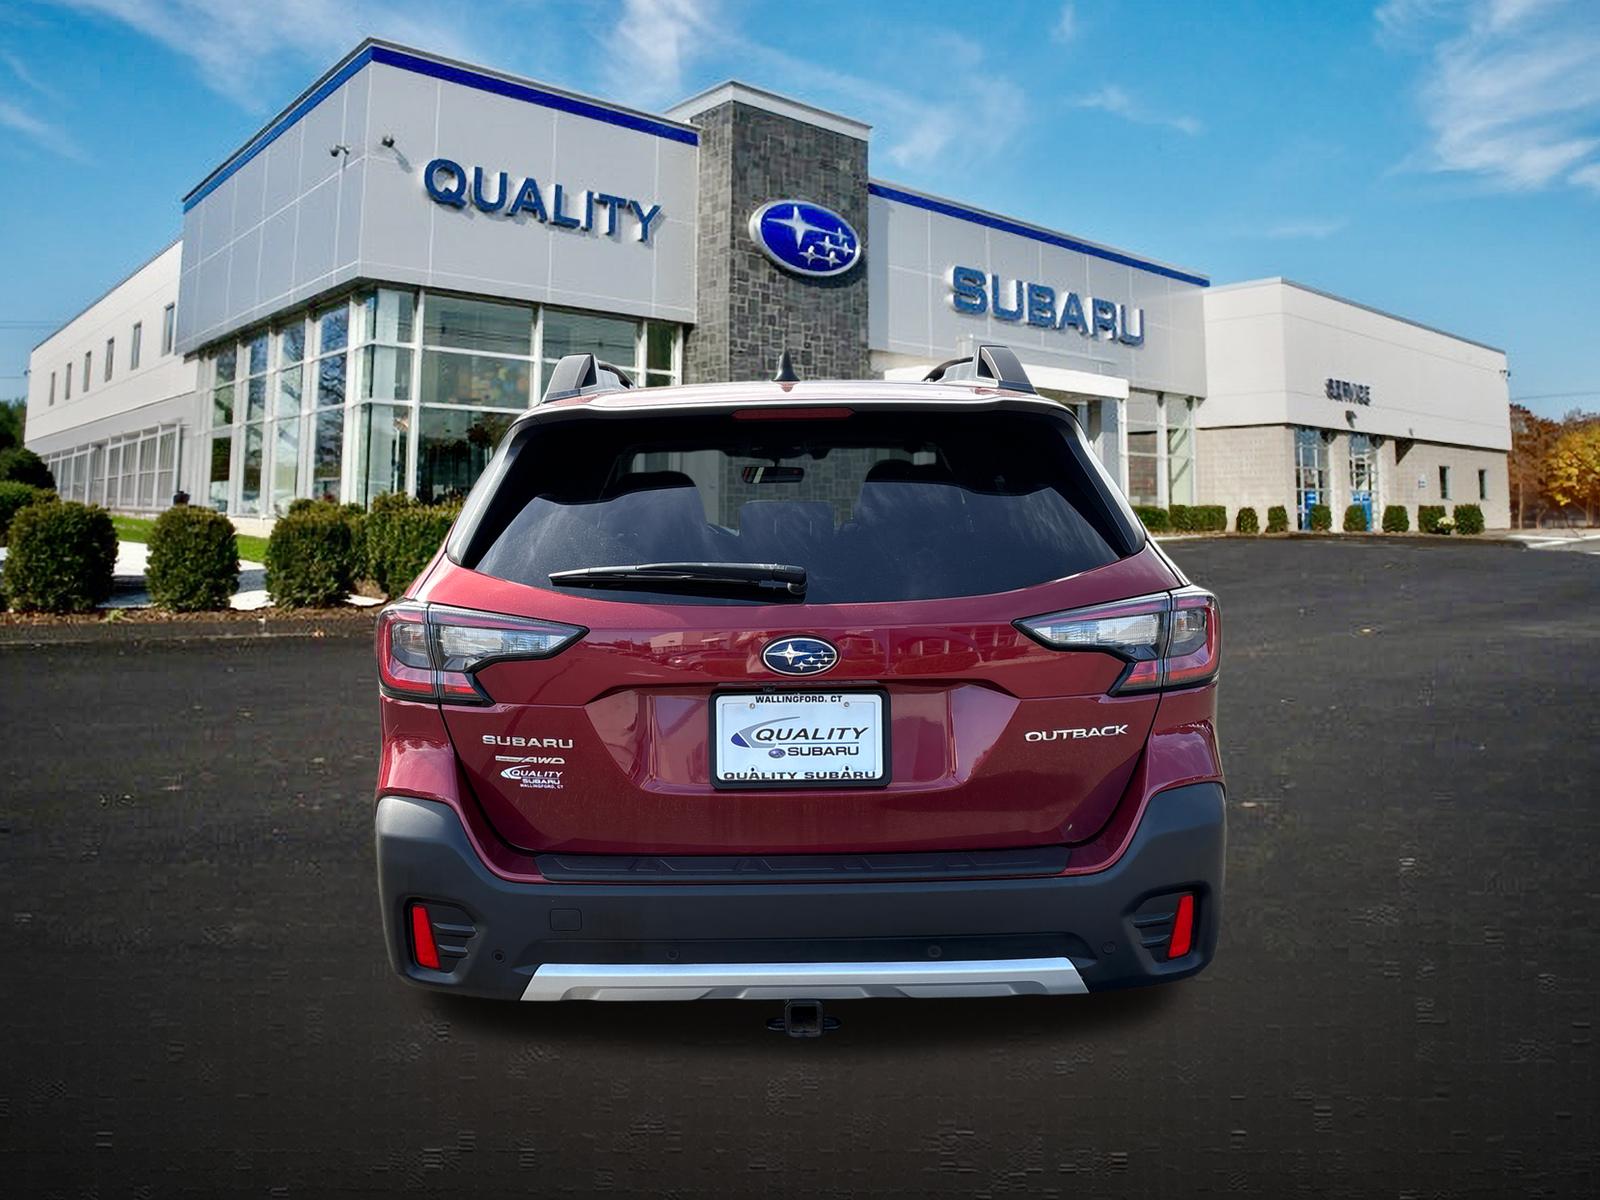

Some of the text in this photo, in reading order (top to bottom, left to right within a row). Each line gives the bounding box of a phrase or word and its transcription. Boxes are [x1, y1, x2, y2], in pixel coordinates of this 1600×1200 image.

[424, 158, 661, 242] QUALITY
[951, 265, 1145, 346] SUBARU
[830, 695, 843, 703] CT
[755, 727, 869, 741] QUALITY
[1024, 724, 1129, 742] OUTBACK
[482, 735, 573, 749] SUBARU
[787, 746, 859, 757] SUBARU
[521, 756, 565, 765] AWD
[511, 769, 563, 778] QUALITY
[723, 771, 876, 780] QUALITY SUBARU
